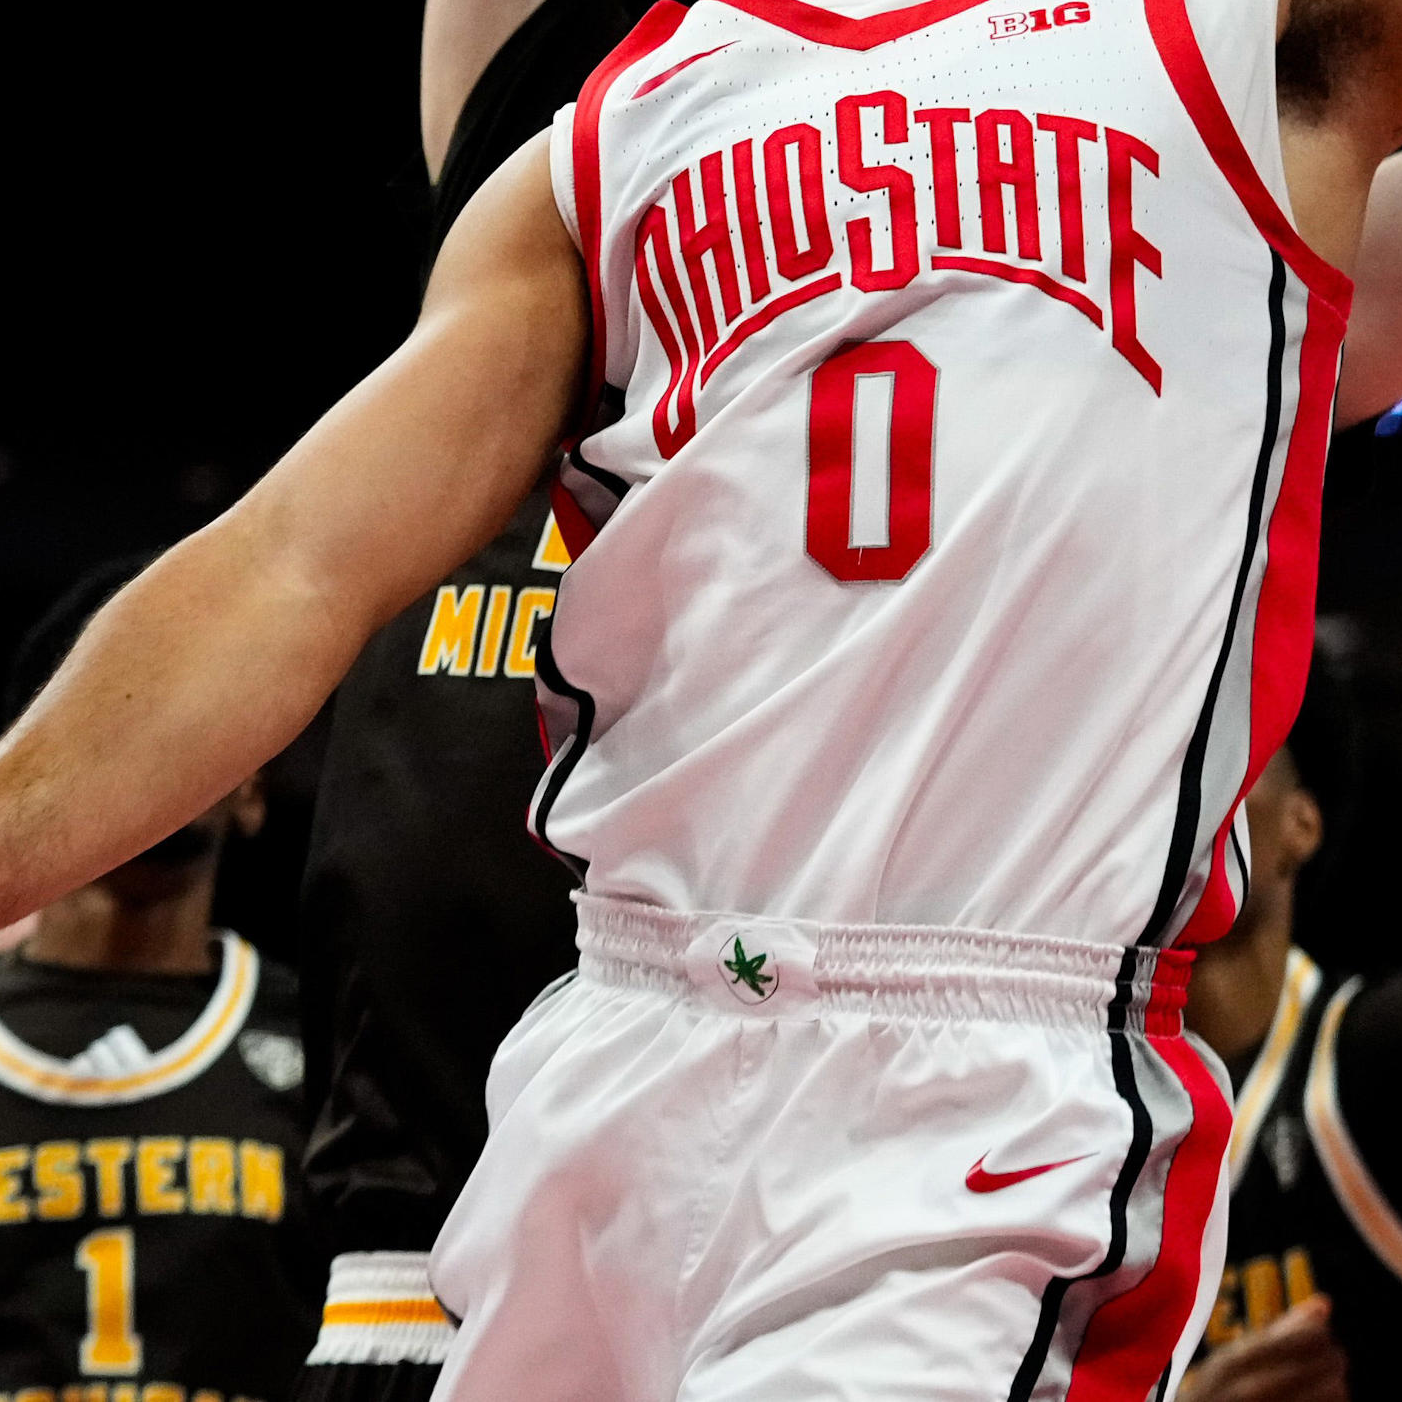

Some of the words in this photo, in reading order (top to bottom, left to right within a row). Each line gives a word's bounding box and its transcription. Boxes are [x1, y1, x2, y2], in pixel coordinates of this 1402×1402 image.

[805, 338, 940, 584] 0
[417, 584, 558, 679] MIC
[77, 1228, 143, 1376] 1
